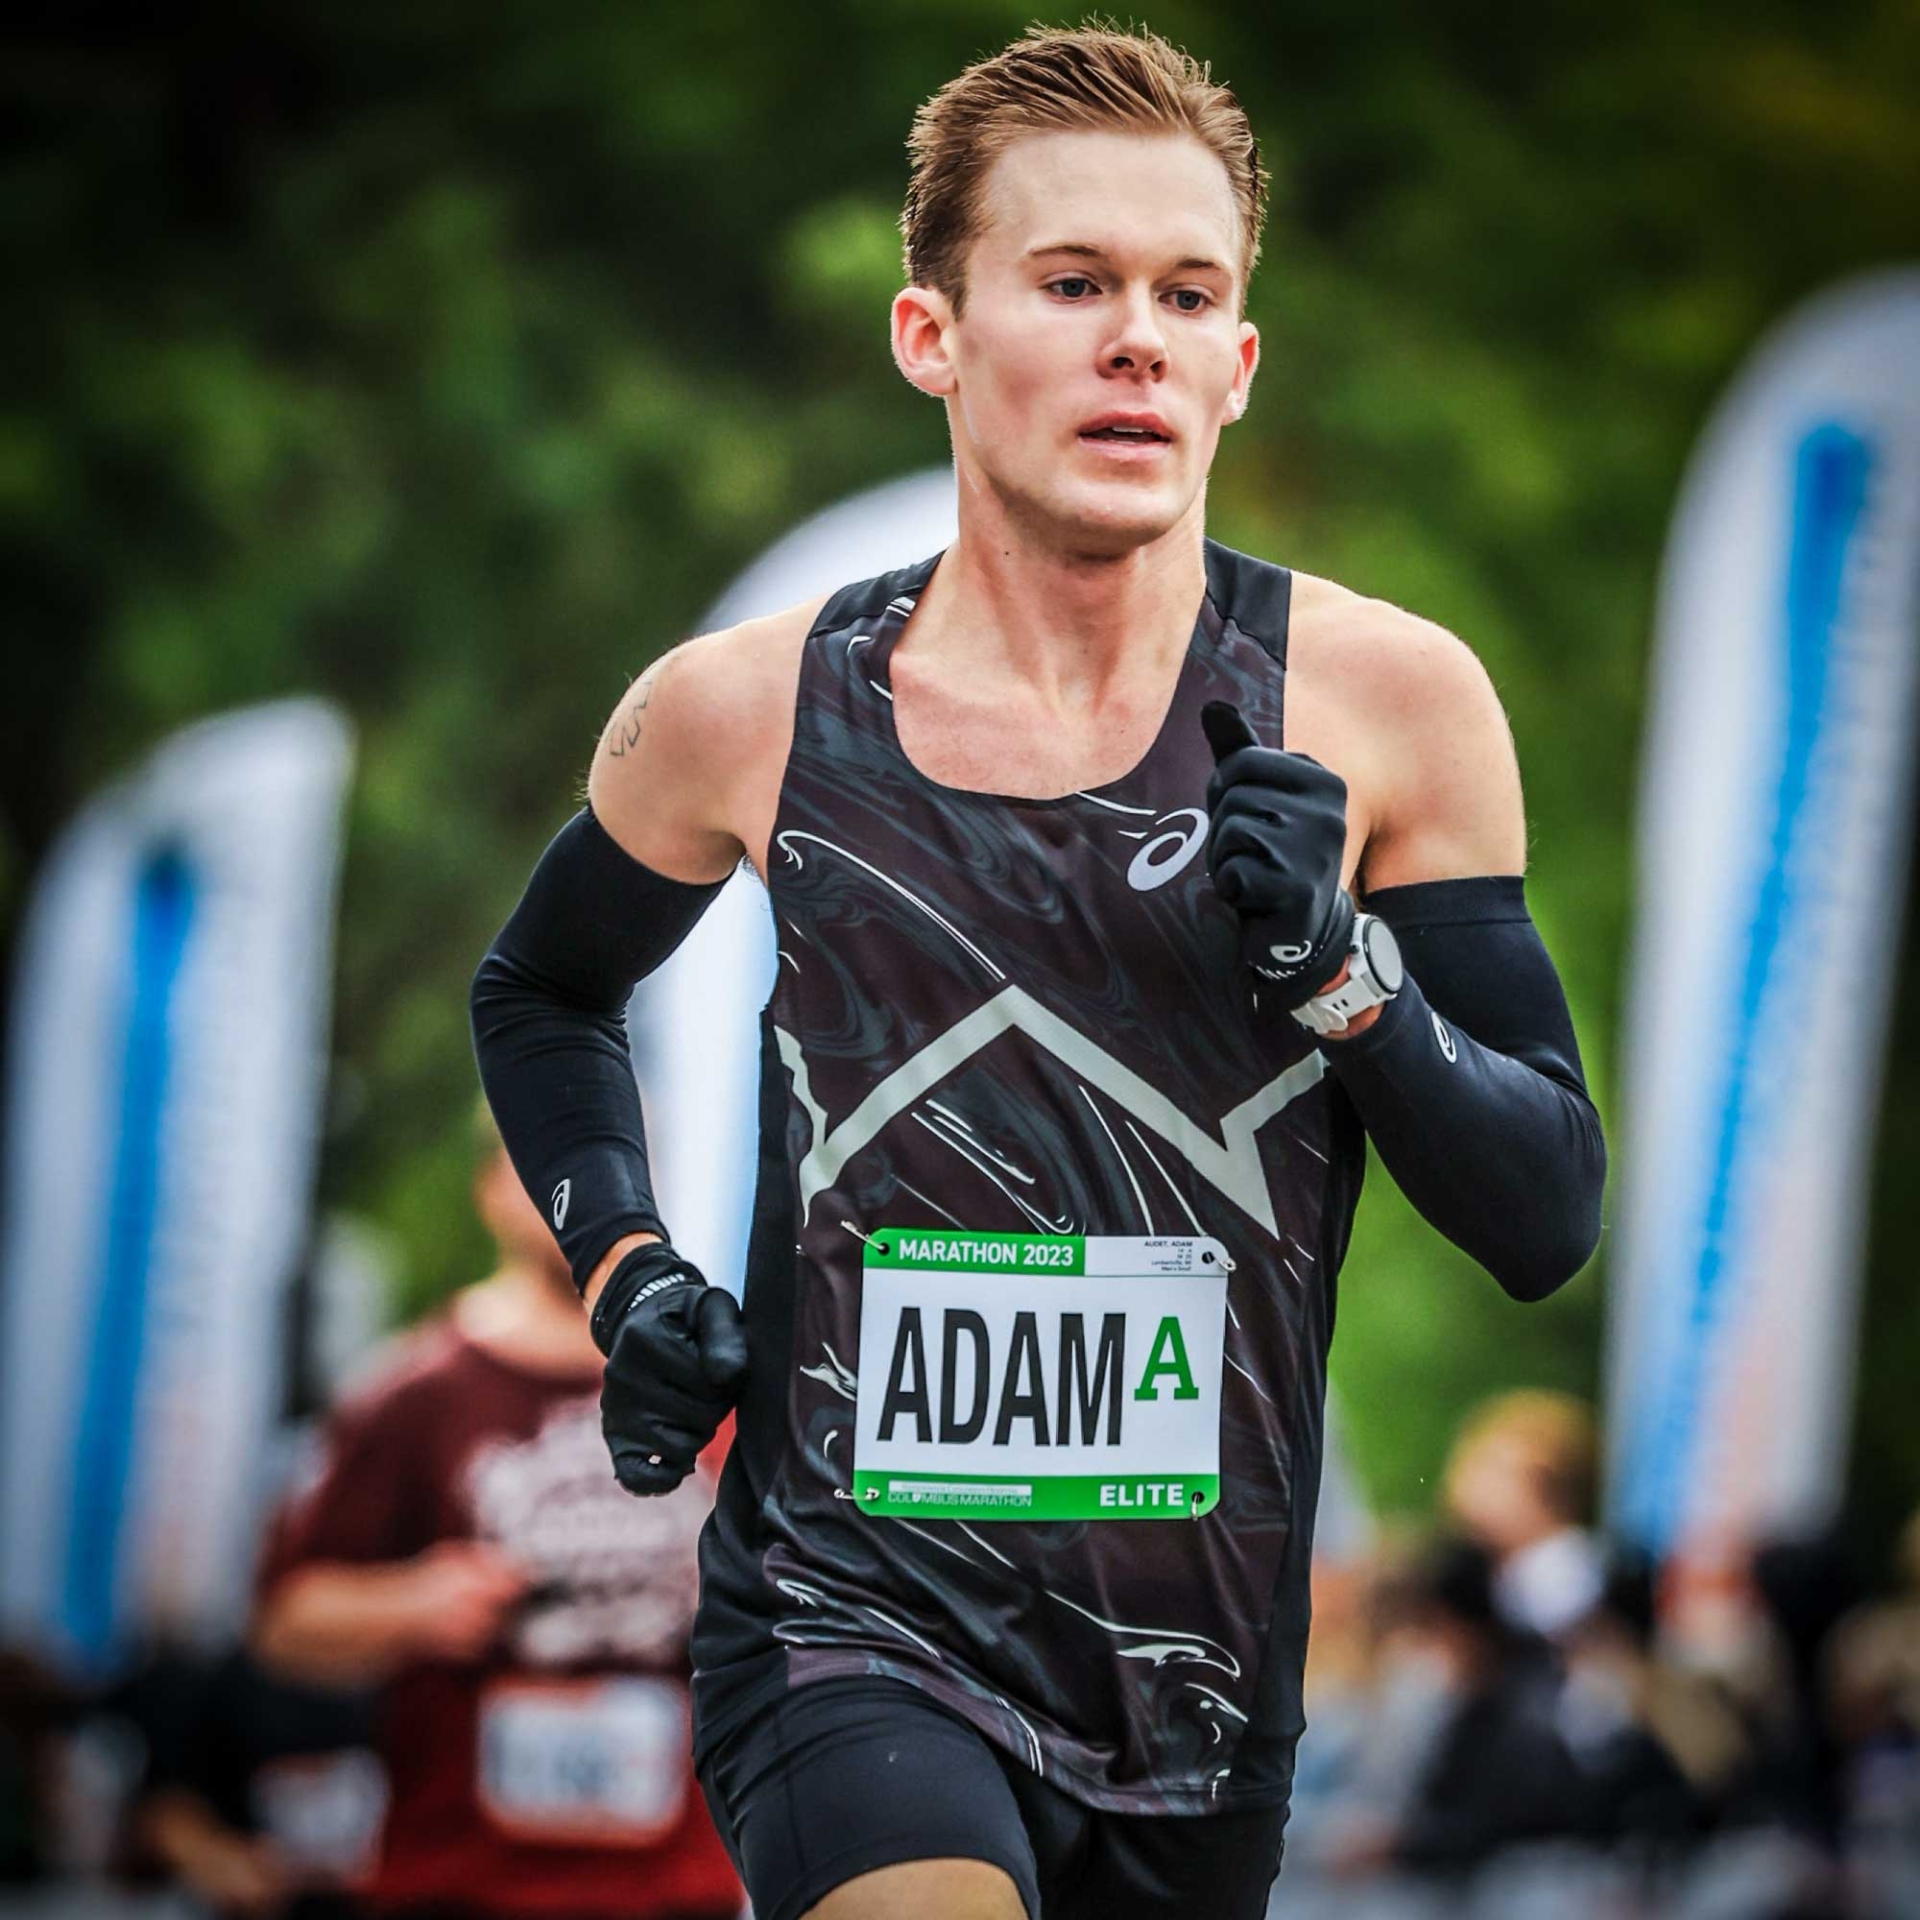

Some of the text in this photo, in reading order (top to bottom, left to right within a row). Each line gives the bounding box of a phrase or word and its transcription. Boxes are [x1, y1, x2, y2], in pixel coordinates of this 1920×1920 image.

[899, 1238, 1075, 1268] MARATHON 2023
[876, 1306, 1200, 1447] ADAM A
[960, 1494, 1032, 1507] MARATHON
[1100, 1484, 1185, 1507] ELITE
